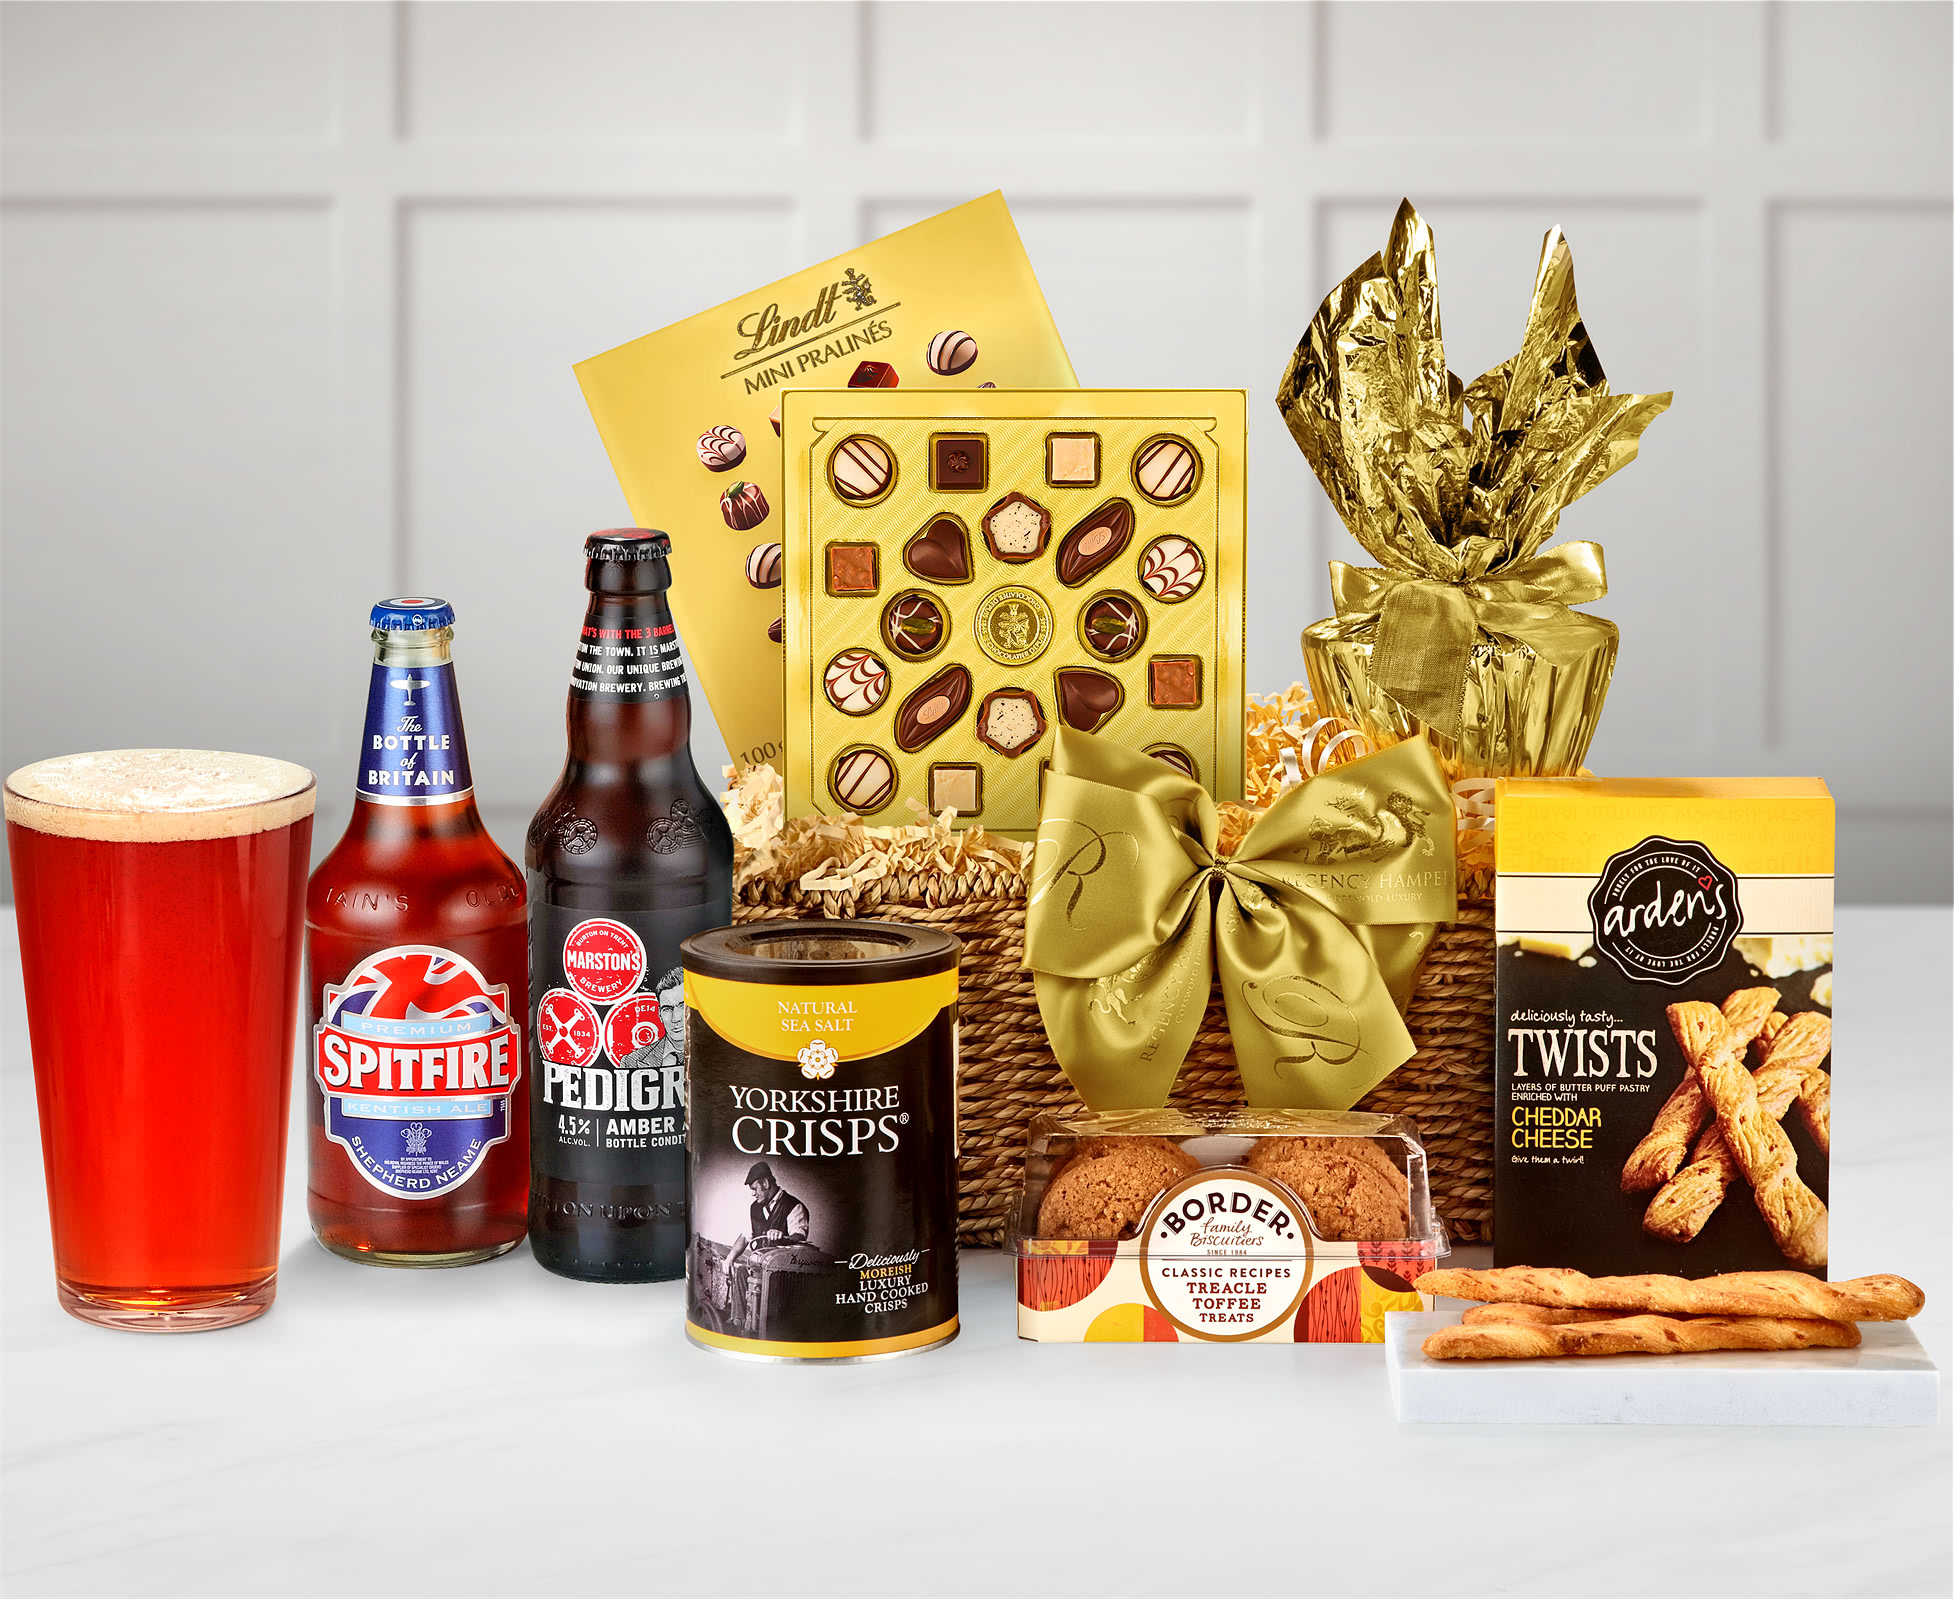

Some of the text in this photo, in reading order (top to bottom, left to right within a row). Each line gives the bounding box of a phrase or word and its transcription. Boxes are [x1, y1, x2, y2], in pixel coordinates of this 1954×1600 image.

[733, 281, 843, 360] Lindt
[744, 320, 893, 395] MINI PRALINÉS
[600, 628, 622, 640] WITH
[625, 628, 643, 640] THE
[646, 627, 652, 639] 3
[590, 645, 603, 656] THE
[605, 646, 634, 657] TOWN.
[637, 646, 646, 656] IT
[649, 645, 659, 658] IS
[582, 661, 604, 675] UNION.
[607, 664, 624, 675] OUR
[627, 662, 660, 675] UNIQUE
[600, 682, 647, 693] BREWERY.
[648, 676, 681, 692] BREWING
[397, 715, 422, 733] The
[373, 735, 451, 750] BOTTLE
[400, 752, 418, 770] of
[740, 742, 776, 766] 100
[368, 770, 454, 786] BRITAIN
[1630, 863, 1643, 874] FOR
[1645, 857, 1658, 866] THE
[1692, 865, 1700, 873] IT
[1282, 873, 1372, 890] REGENCY
[576, 930, 598, 947] BURTON
[610, 932, 629, 948] TRENT
[567, 950, 640, 971] MARSTON'S
[580, 977, 623, 993] BREWERY
[635, 1005, 656, 1013] DE14
[778, 1001, 858, 1015] NATURAL
[781, 1018, 854, 1032] SEA SALT
[1511, 1009, 1624, 1029] deliciously tasty...
[361, 1022, 472, 1035] PREMIUM
[542, 1024, 554, 1032] EST.
[573, 1030, 591, 1038] 1834
[1507, 1028, 1658, 1079] TWISTS
[323, 1033, 510, 1091] SPITFIRE
[542, 1060, 685, 1112] PEDIGR
[1511, 1083, 1651, 1093] LAYERS OF BUTTER PUFF PASTRY
[729, 1085, 900, 1113] YORKSHIRE
[1511, 1092, 1578, 1101] ENRICHED WITH
[348, 1102, 441, 1114] KENTISH
[450, 1102, 488, 1113] ALE
[558, 1114, 591, 1136] 4.5%
[1511, 1106, 1602, 1128] CHEDDAR
[606, 1116, 676, 1135] AMBER
[558, 1136, 591, 1147] ALC.VOL.
[606, 1138, 647, 1148] BOTTLE
[1511, 1128, 1593, 1149] CHEESE
[351, 1135, 482, 1189] SHEPHERD NEAME
[1511, 1155, 1530, 1164] Give
[1531, 1155, 1551, 1164] them
[600, 1201, 672, 1219] UPON
[1161, 1192, 1290, 1236] BORDER
[1200, 1217, 1252, 1236] family
[1190, 1232, 1264, 1247] Biscuitiers
[849, 1248, 920, 1270] Deliciously
[860, 1264, 912, 1280] MOREISH
[1162, 1268, 1291, 1278] CLASSIC RECIPES
[859, 1275, 912, 1291] LUXURY
[1186, 1282, 1267, 1294] TREACLE
[835, 1282, 929, 1304] HAND COOKED
[864, 1299, 908, 1314] CRISPS
[1192, 1298, 1261, 1309] TOFFEE
[1199, 1313, 1254, 1323] TREATS
